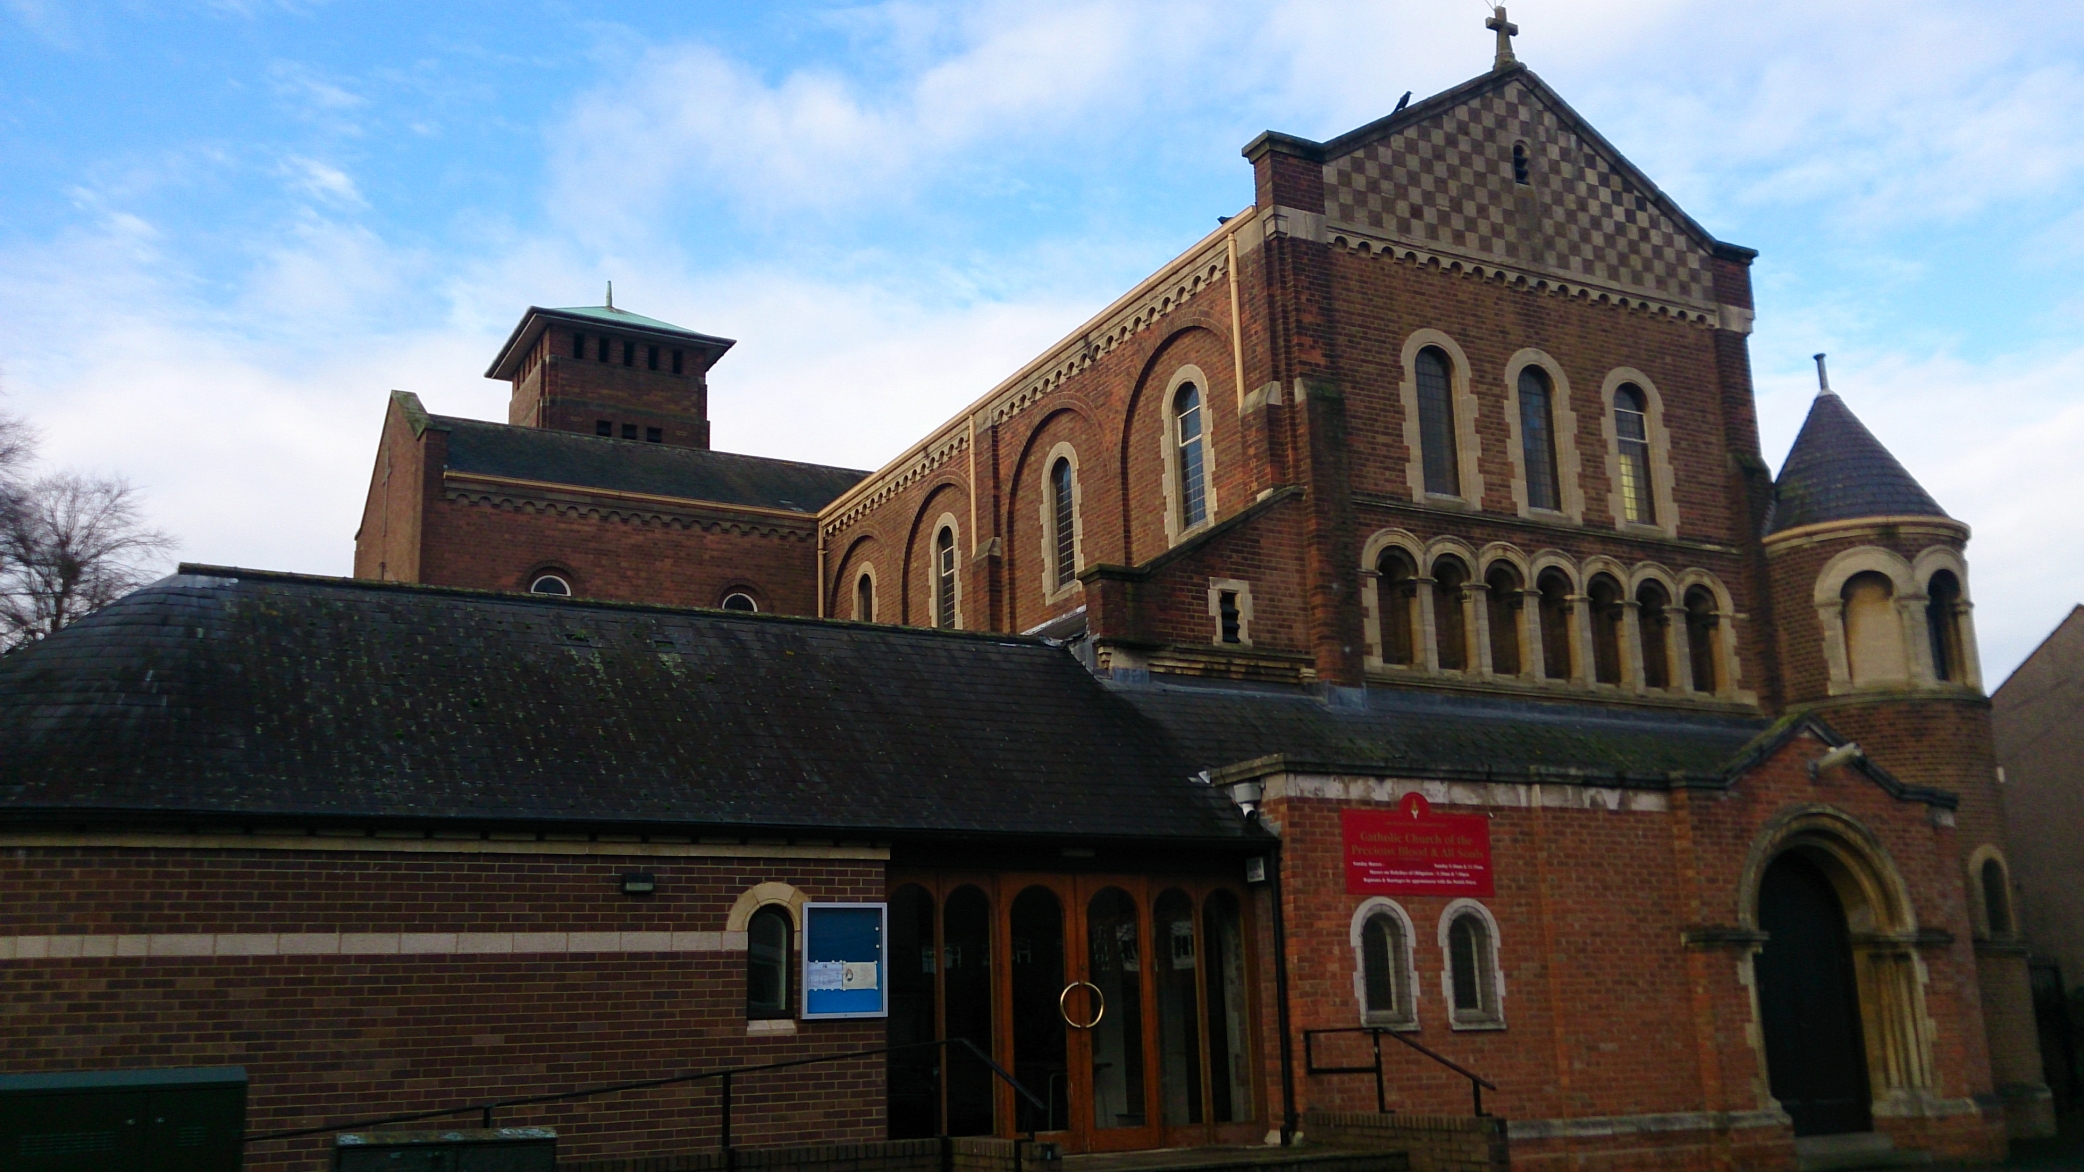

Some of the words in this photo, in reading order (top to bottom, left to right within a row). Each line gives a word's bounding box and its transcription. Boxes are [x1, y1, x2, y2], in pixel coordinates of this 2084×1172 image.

[1360, 831, 1402, 843] Catholic
[1405, 833, 1442, 845] Church
[1444, 833, 1455, 845] of
[1457, 835, 1473, 846] the
[1351, 844, 1396, 856] Precious
[1398, 845, 1428, 857] Blood
[1430, 847, 1438, 857] &
[1442, 847, 1455, 858] All
[1457, 848, 1484, 859] Souls
